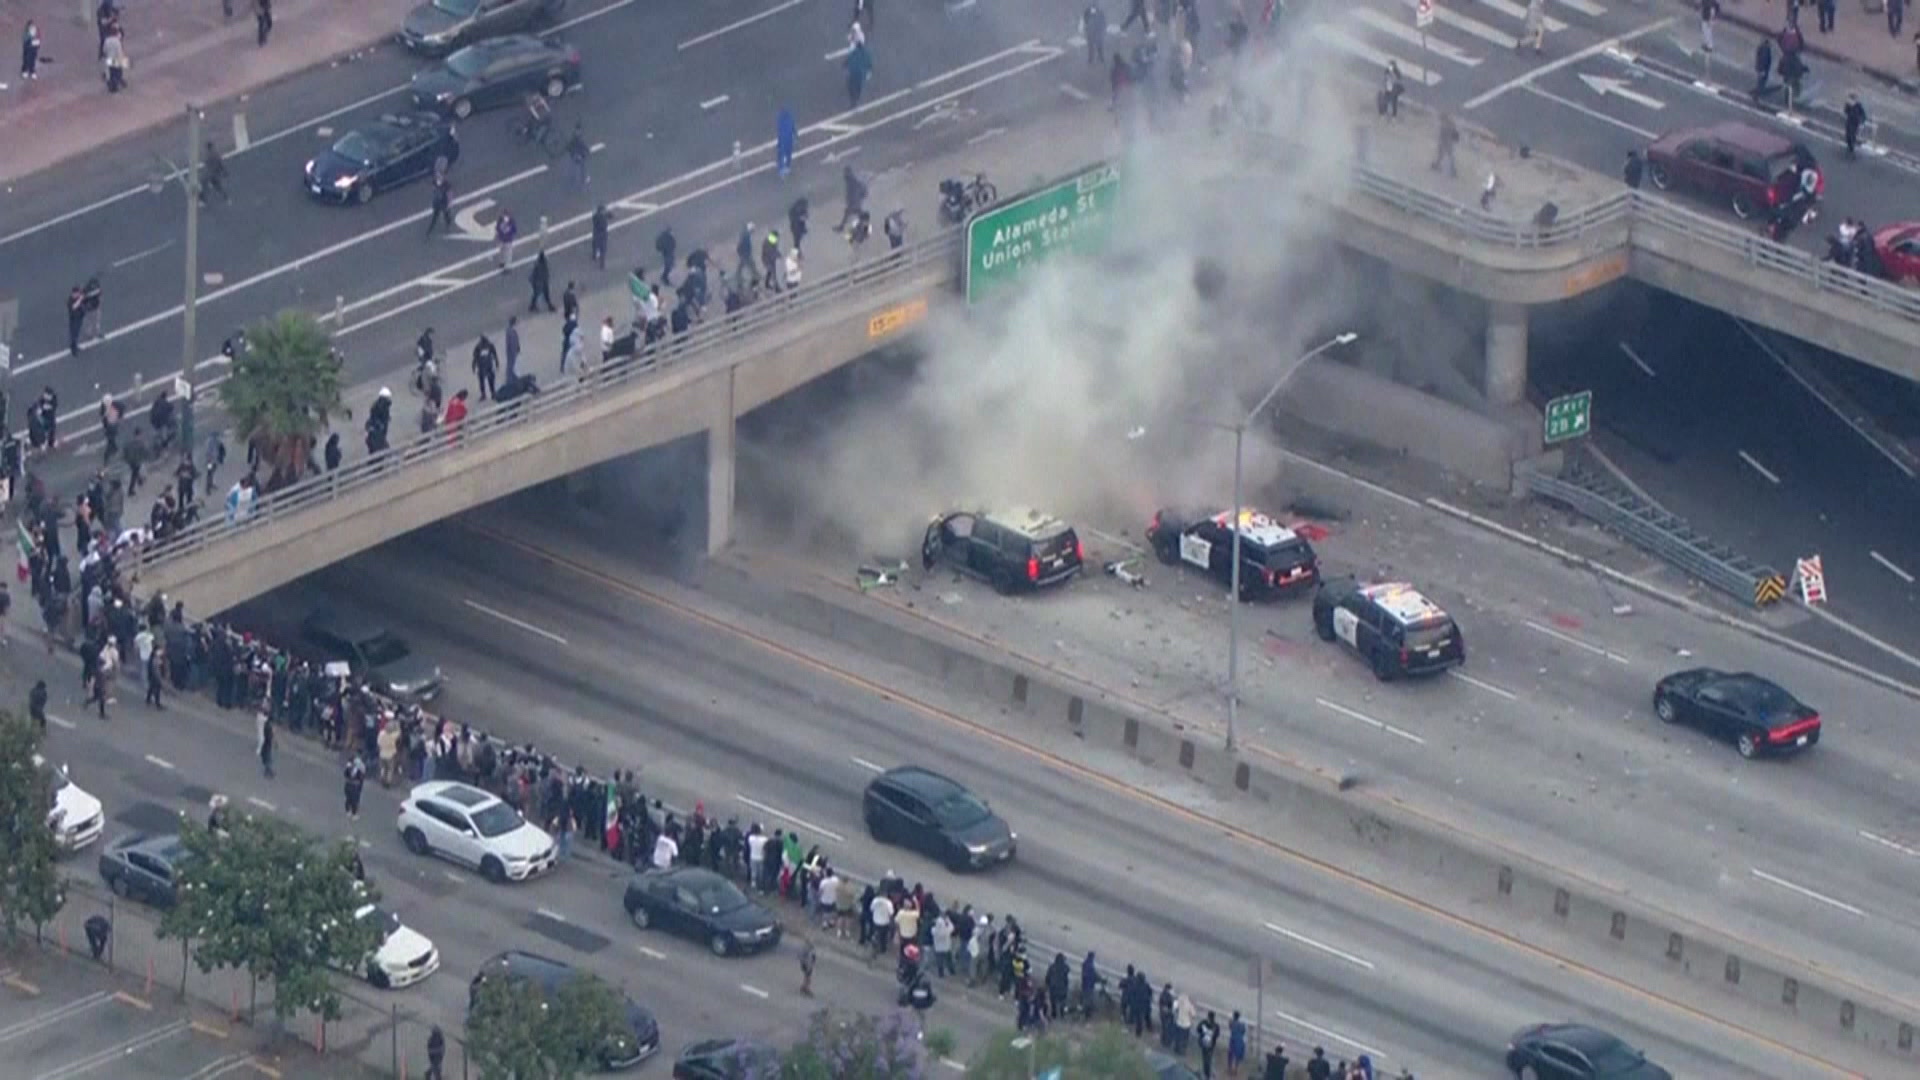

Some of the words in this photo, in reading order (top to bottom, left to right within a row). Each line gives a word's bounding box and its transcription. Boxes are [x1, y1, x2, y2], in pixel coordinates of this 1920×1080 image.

[993, 206, 1068, 247] Alameda
[1076, 192, 1095, 213] St
[982, 239, 1033, 269] Union
[1551, 399, 1584, 417] EXIT
